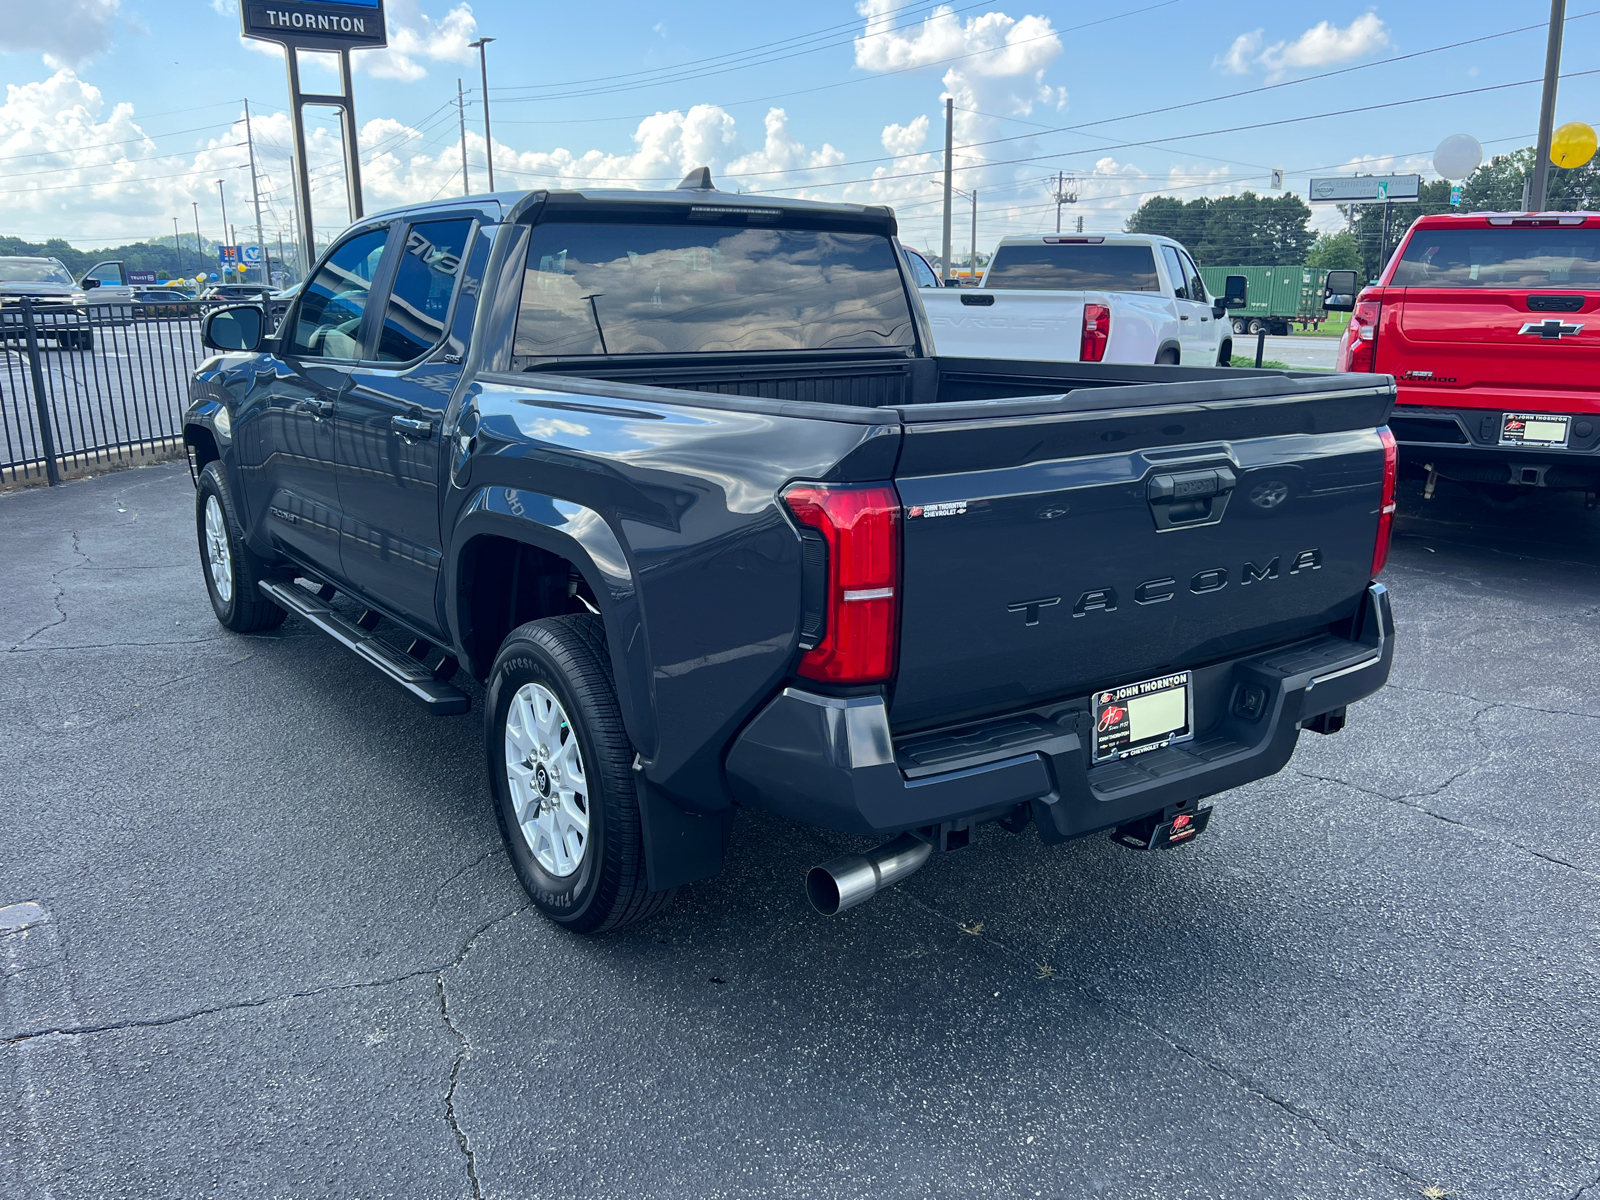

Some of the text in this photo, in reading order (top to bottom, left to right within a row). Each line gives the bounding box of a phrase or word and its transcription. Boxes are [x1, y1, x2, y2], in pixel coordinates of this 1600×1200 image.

[266, 10, 365, 33] THORNTON
[1335, 180, 1371, 188] CERTIFIED
[1394, 375, 1457, 383] LVERADO
[1177, 480, 1216, 494] TOYOTA
[923, 501, 967, 512] JOHN THORNTON
[923, 509, 956, 518] CHEVROLET
[1007, 548, 1323, 627] TACOMA
[502, 656, 554, 686] Firestone
[1116, 674, 1187, 700] JOHN THORNTON
[1130, 743, 1160, 756] CHEVROLET
[520, 865, 571, 909] Firestone
